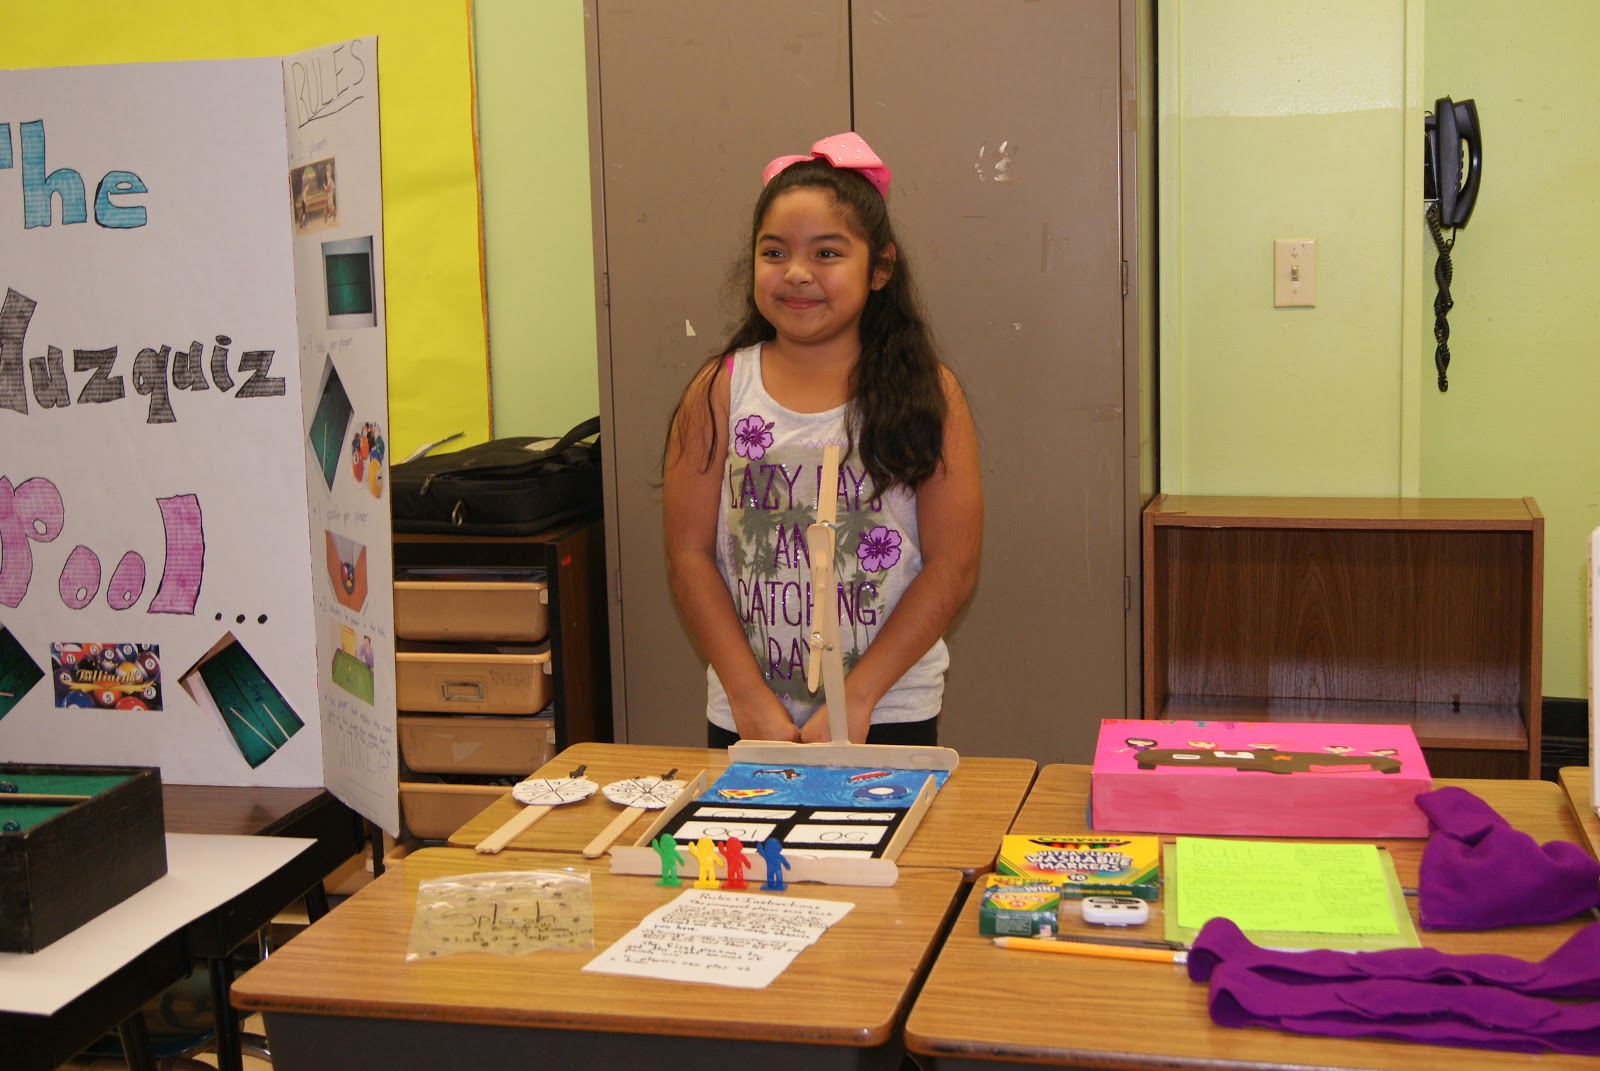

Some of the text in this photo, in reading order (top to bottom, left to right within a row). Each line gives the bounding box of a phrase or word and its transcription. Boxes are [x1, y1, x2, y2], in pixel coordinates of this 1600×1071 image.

[291, 39, 365, 126] RULES
[729, 463, 883, 513] LAZY AY
[773, 522, 813, 570] AN
[737, 578, 878, 627] CATCNG
[767, 636, 812, 682] RA
[703, 826, 758, 839] 100
[1038, 850, 1123, 859] ULTRA-CLEAN
[1025, 852, 1132, 868] WASHABLE
[1038, 861, 1121, 872] MARKERS
